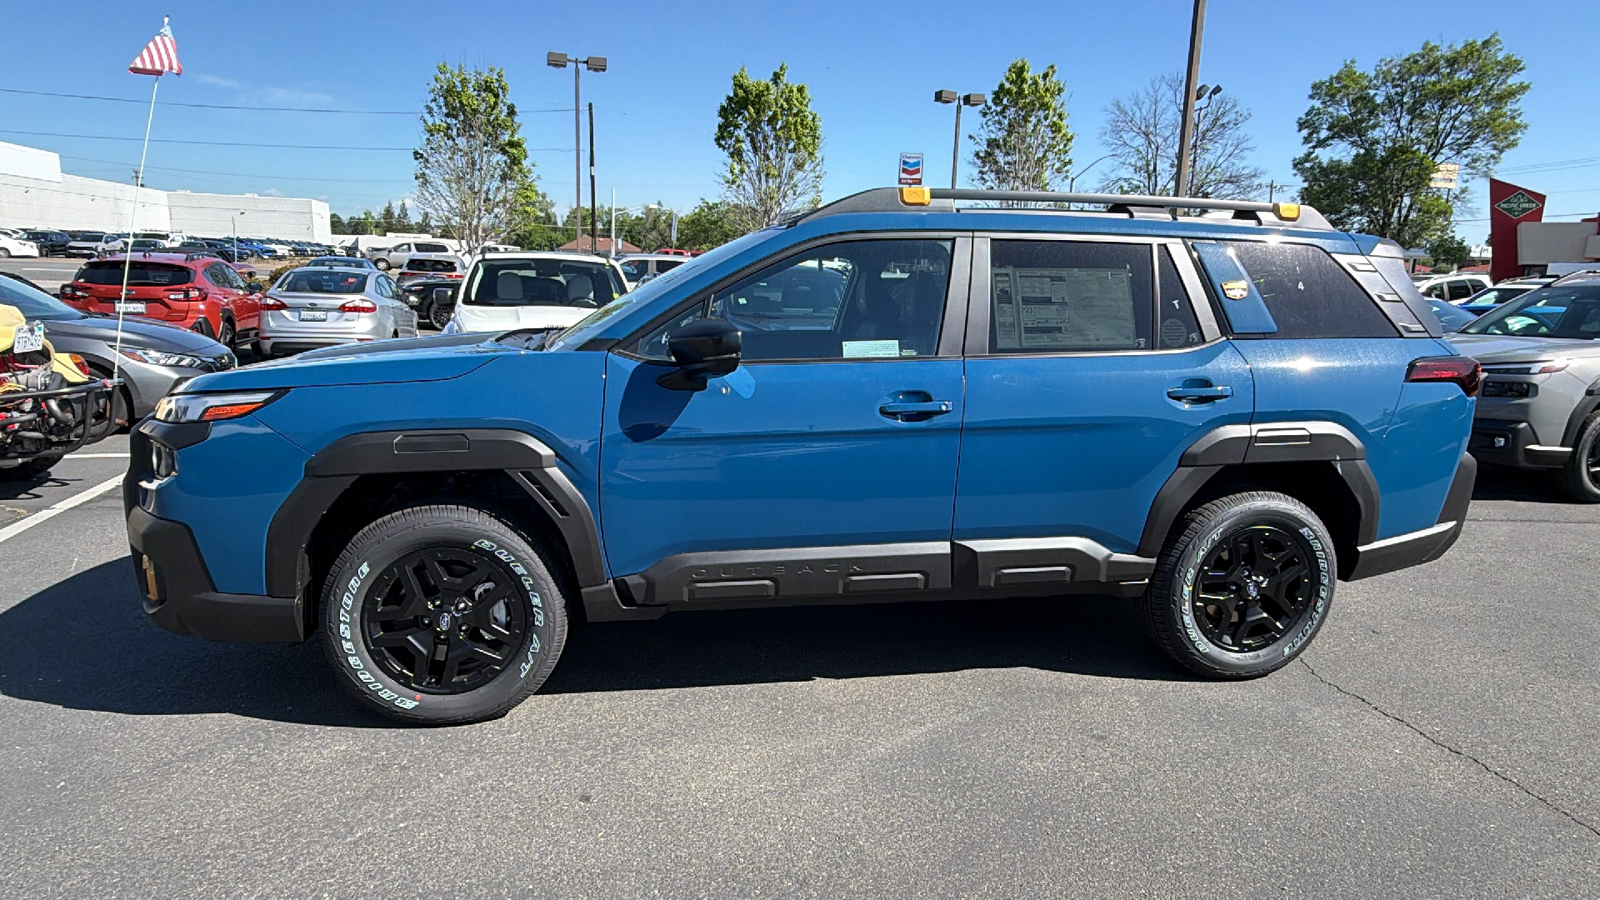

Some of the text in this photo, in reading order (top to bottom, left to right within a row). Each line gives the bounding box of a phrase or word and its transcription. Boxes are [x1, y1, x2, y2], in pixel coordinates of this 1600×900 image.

[472, 538, 544, 679] DUELER A/T
[691, 562, 863, 579] OUTBACK
[1181, 527, 1223, 654] DUELER A/T
[1283, 527, 1330, 657] BRIDGESTONE
[338, 561, 420, 711] BRIDGESTONE
